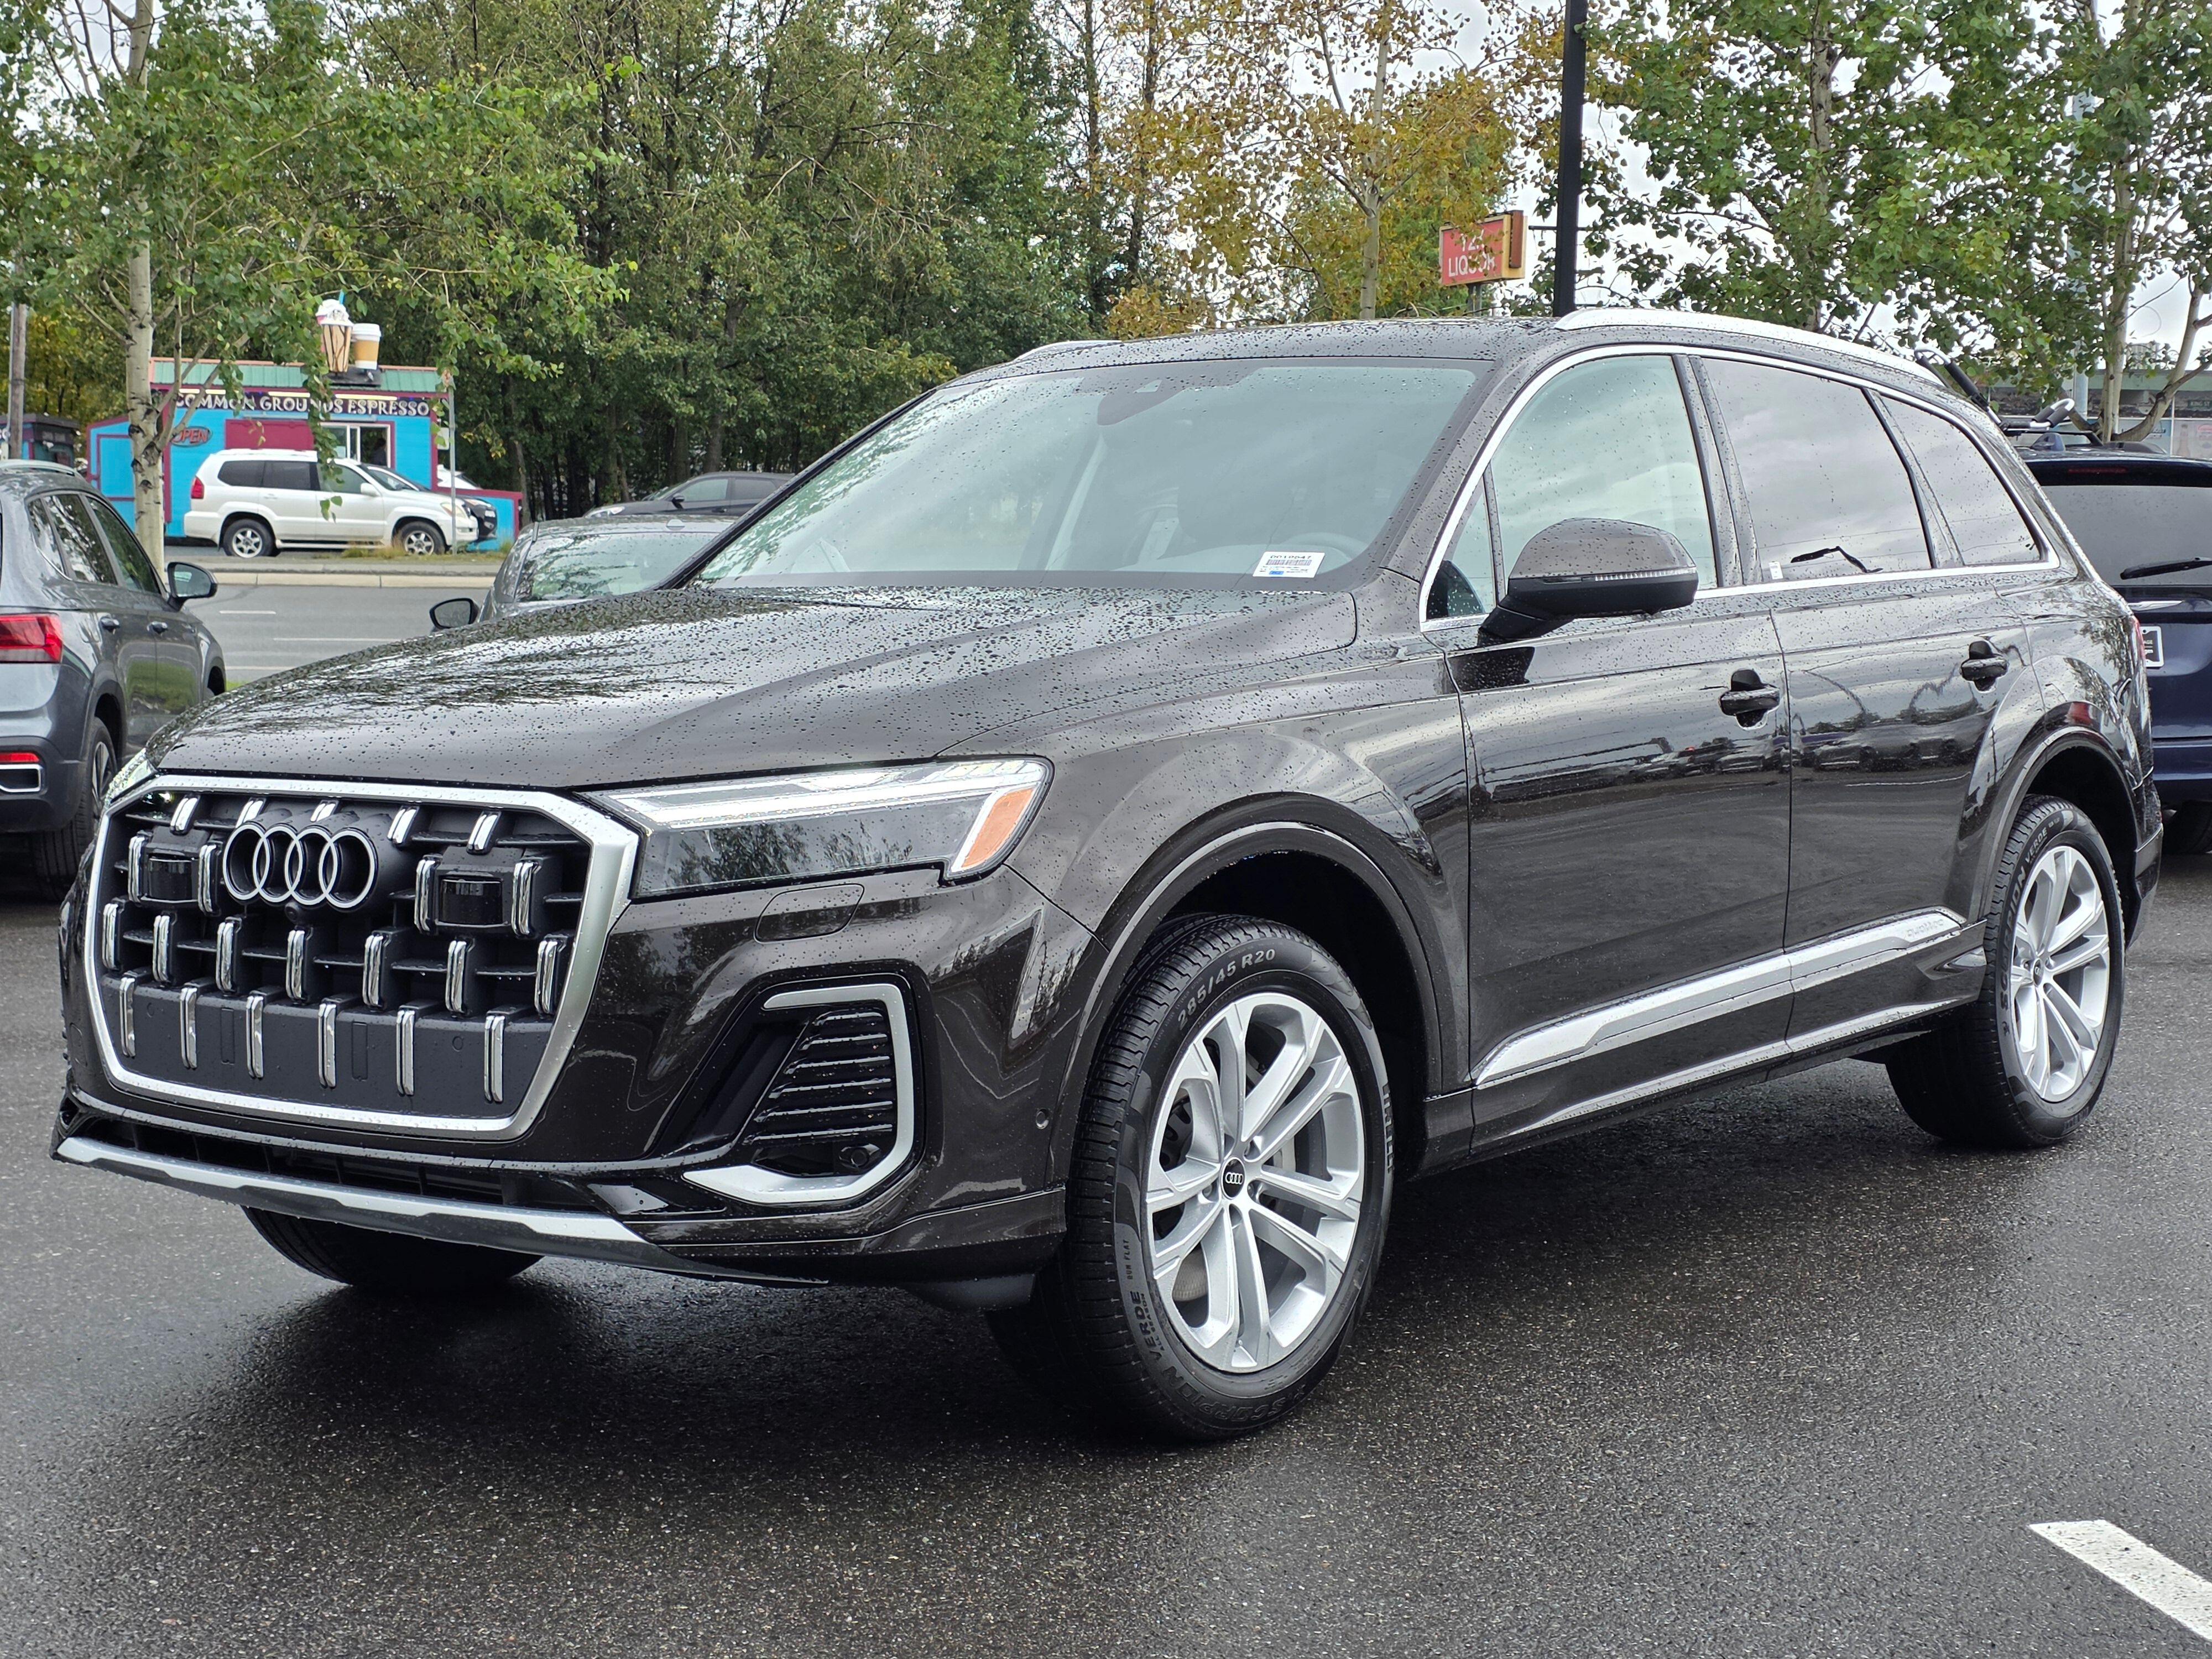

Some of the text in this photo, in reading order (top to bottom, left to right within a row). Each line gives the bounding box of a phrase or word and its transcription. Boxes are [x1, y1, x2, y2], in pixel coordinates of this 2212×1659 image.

[348, 399, 430, 416] ESPRESSO
[2025, 827, 2048, 863] VERDE
[1178, 961, 1236, 1030] 285/45
[1241, 948, 1276, 968] R20
[1125, 1264, 1134, 1280] RUN
[1140, 1293, 1165, 1351] ALL SEASON
[1130, 1290, 1286, 1422] SCORPION VERDE
